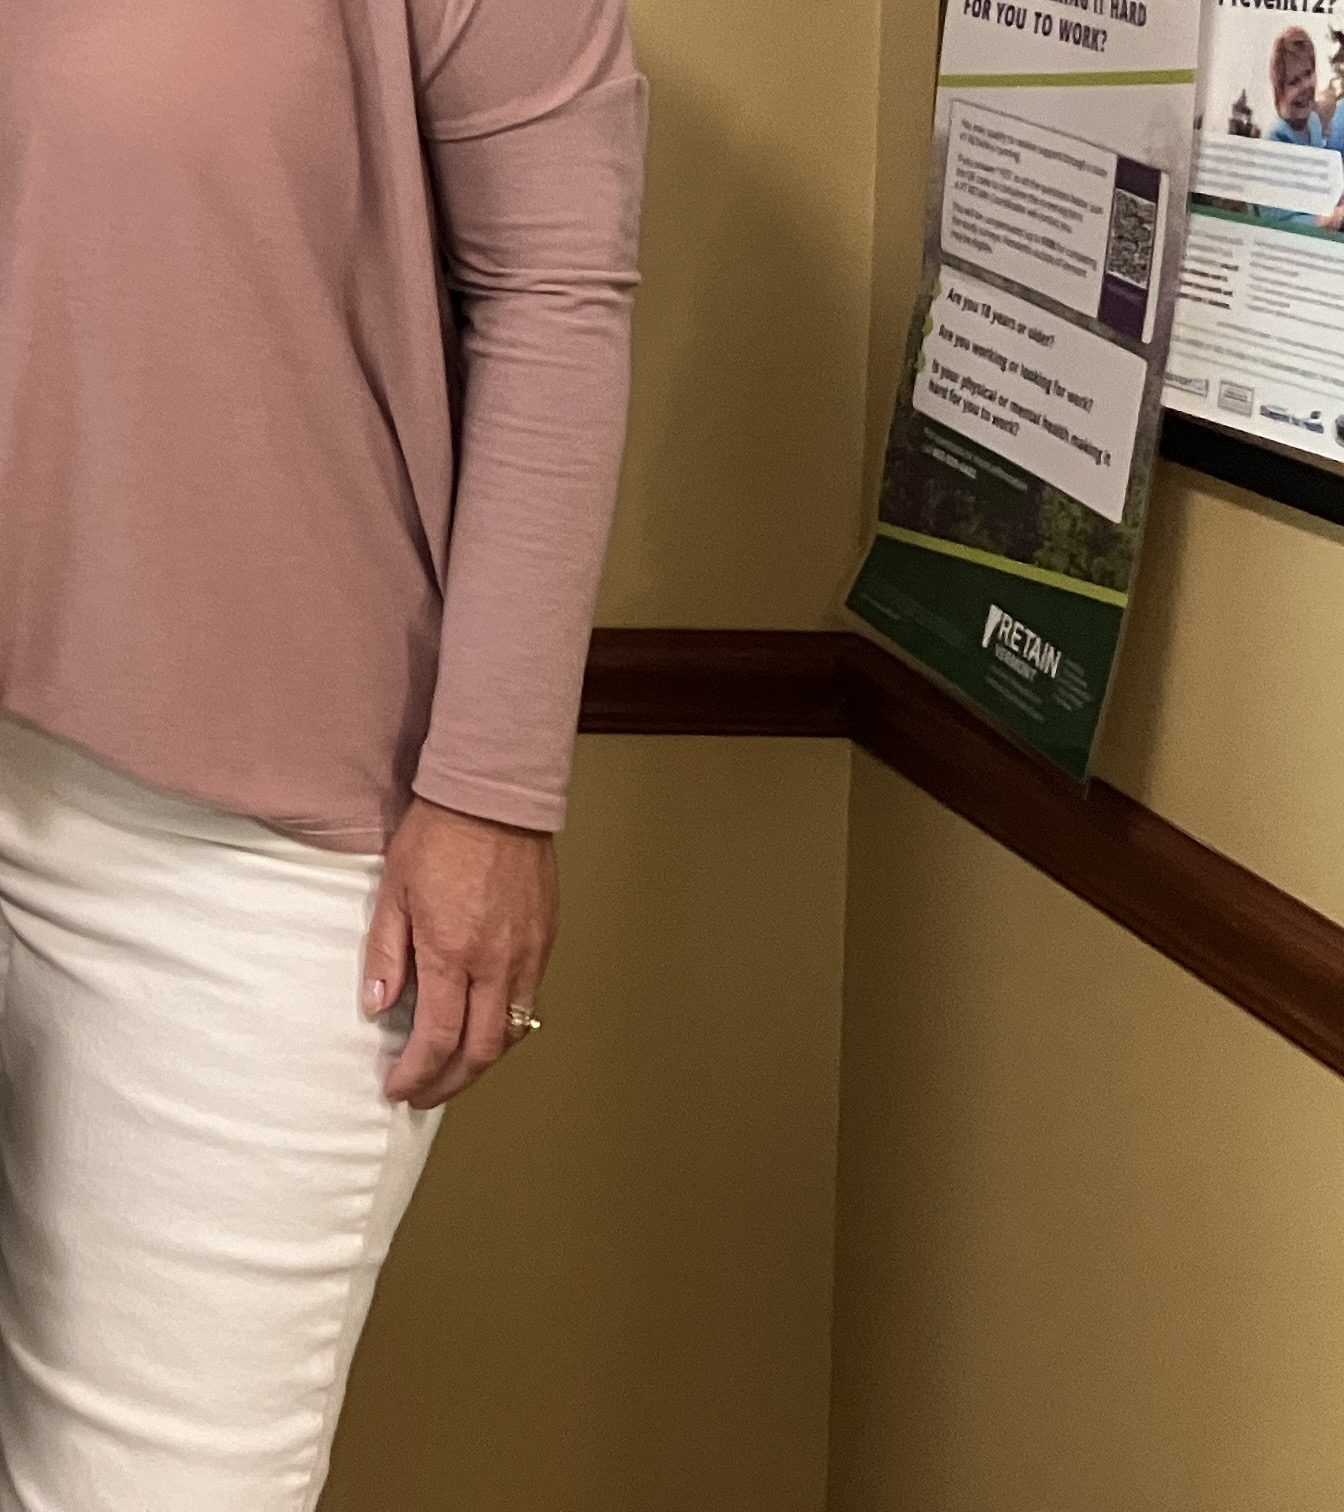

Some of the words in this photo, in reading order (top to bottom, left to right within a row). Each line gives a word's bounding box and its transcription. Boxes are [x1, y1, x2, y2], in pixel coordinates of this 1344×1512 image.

[997, 2, 1027, 29] YOU
[1034, 12, 1053, 37] TO
[1059, 18, 1108, 52] WORK?
[998, 613, 1063, 679] RETAIN
